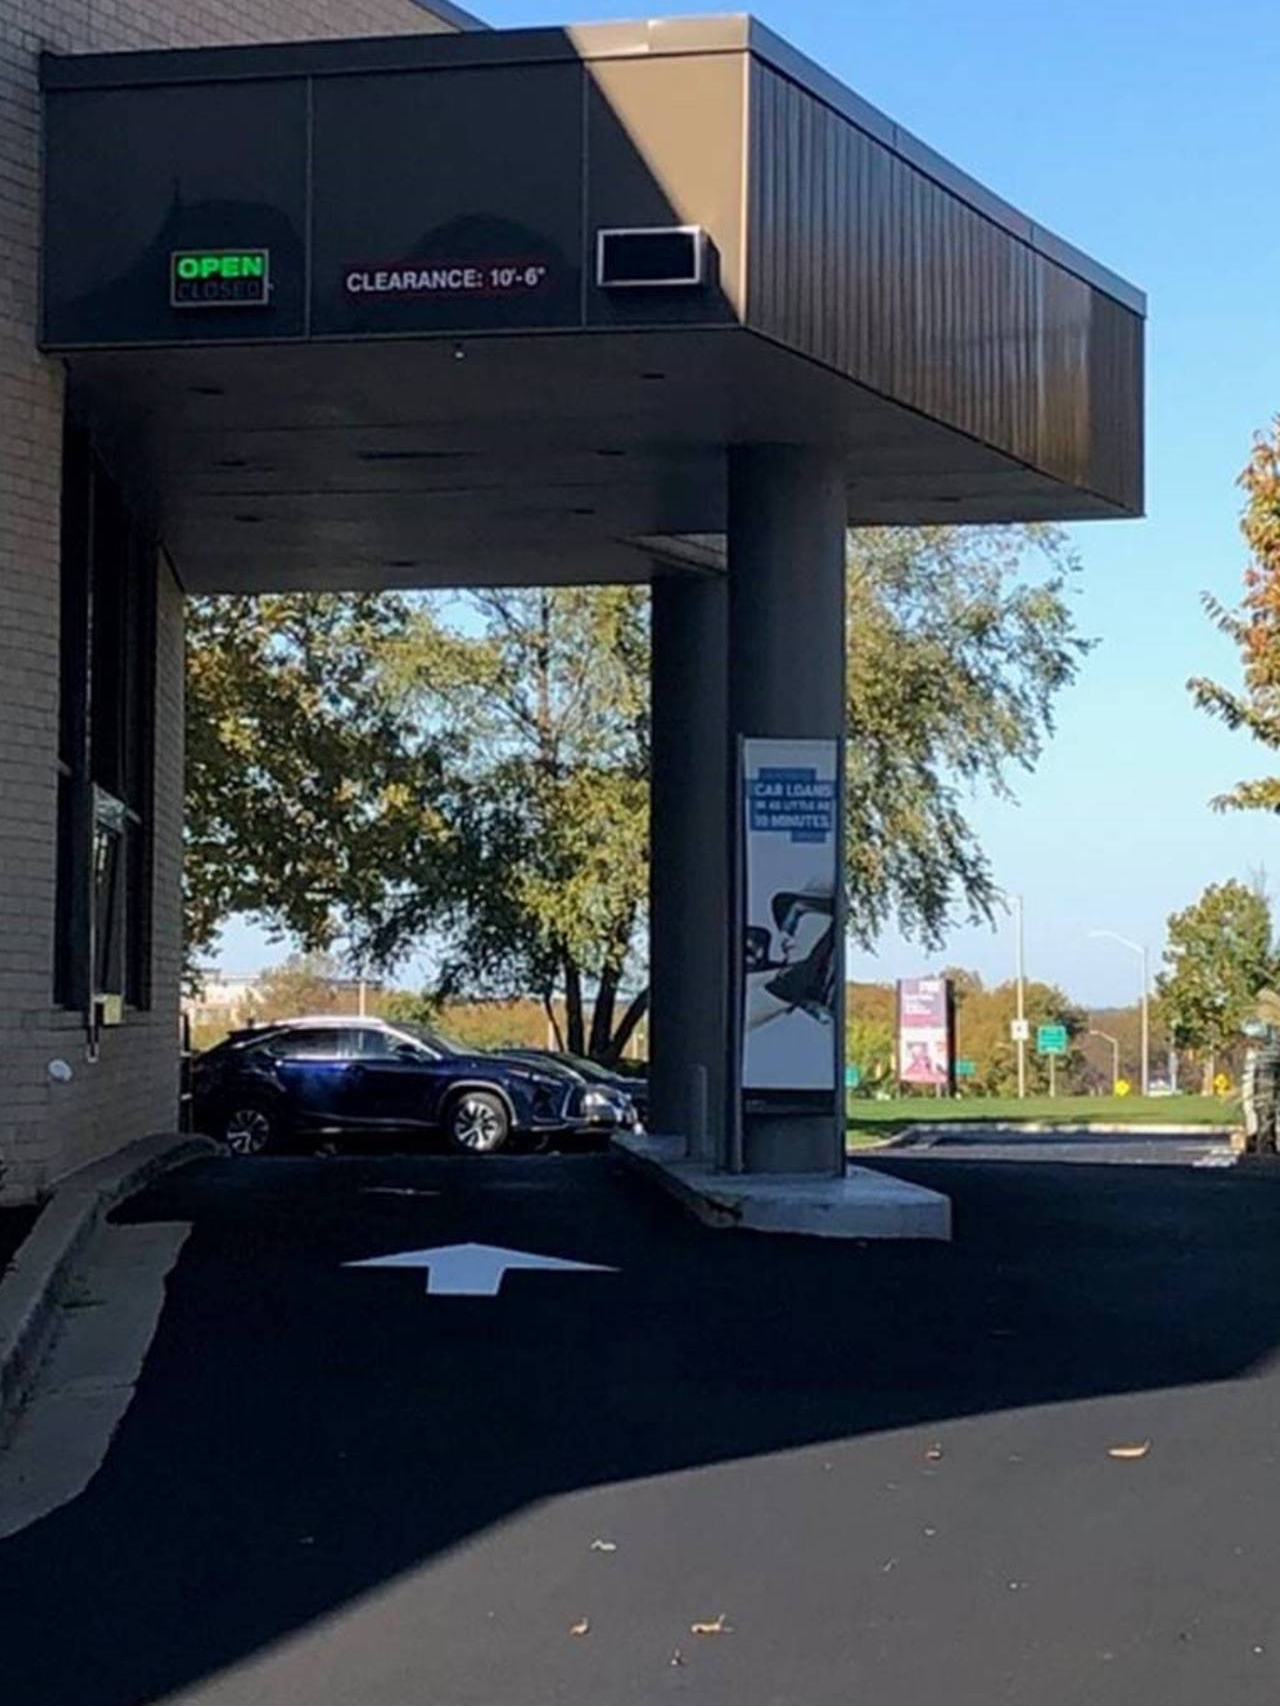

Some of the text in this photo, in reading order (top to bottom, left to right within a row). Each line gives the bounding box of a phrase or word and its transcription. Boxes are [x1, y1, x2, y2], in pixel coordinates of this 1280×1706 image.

[177, 256, 264, 279] OPEN
[177, 281, 261, 300] CLOSED
[346, 269, 484, 293] CLEARANCE:
[754, 783, 833, 797] CAR LOANS
